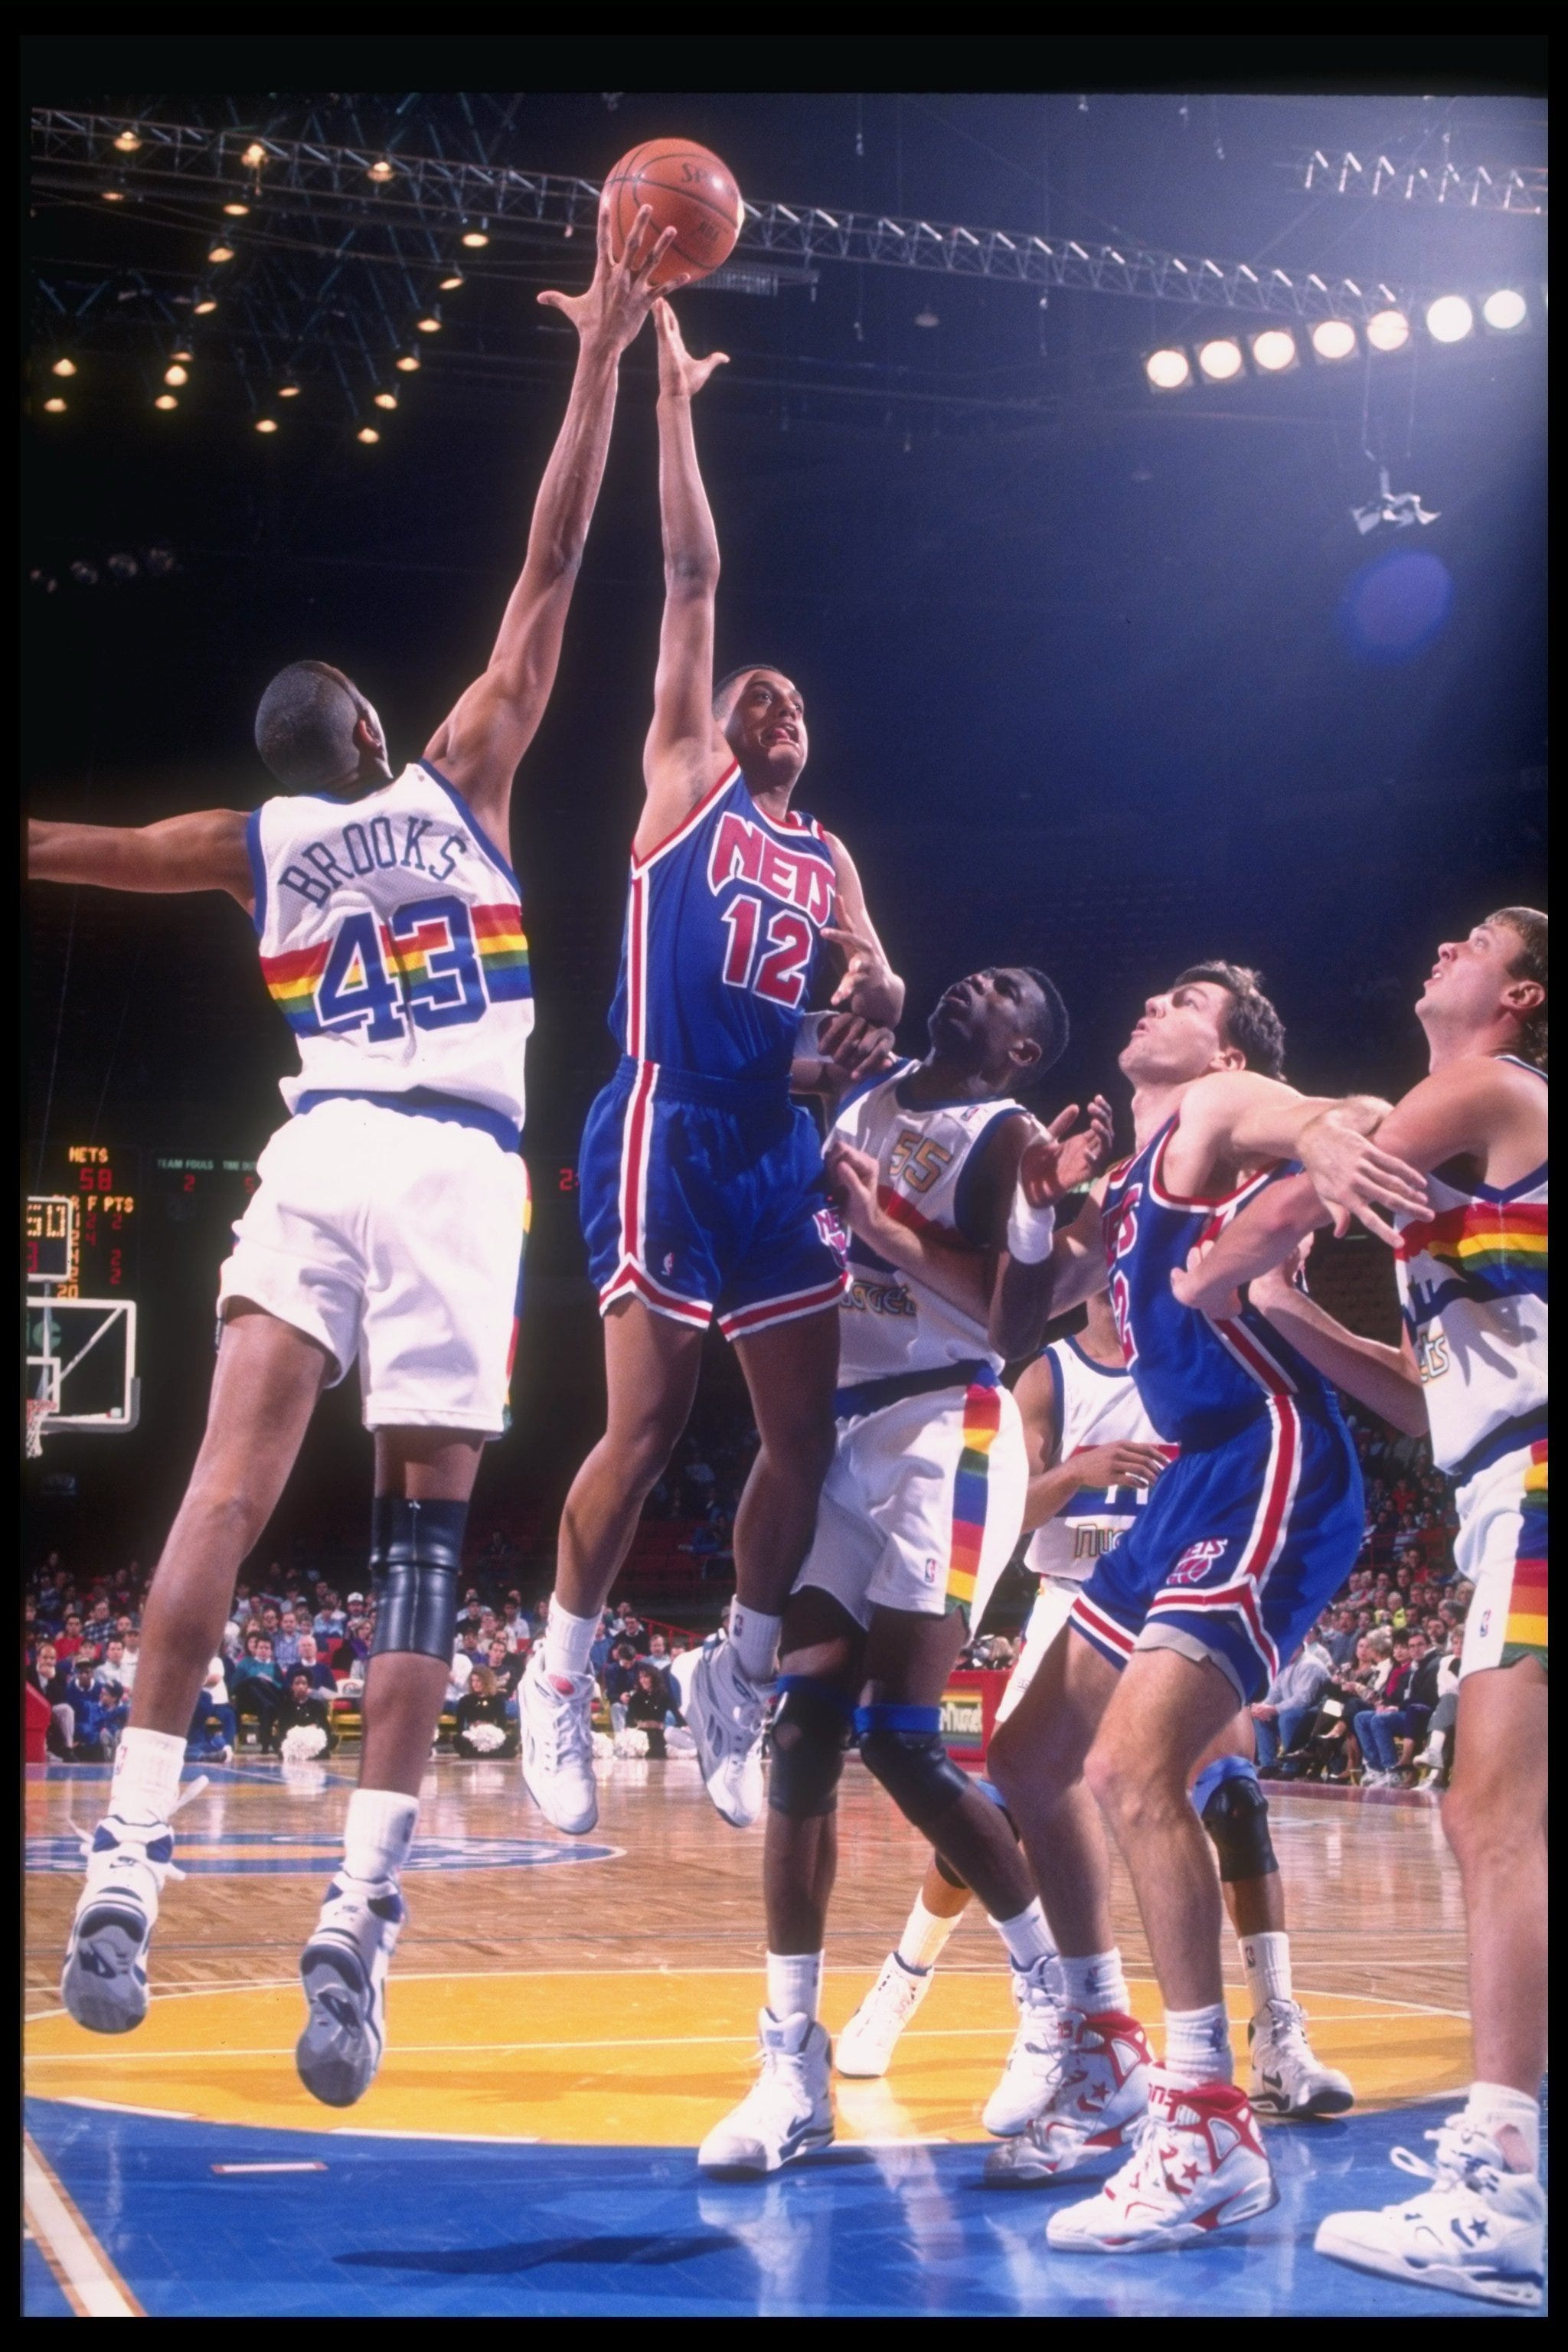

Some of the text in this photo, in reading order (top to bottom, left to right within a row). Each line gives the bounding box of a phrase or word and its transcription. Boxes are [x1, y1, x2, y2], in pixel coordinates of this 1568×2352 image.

[278, 815, 467, 909] BROOKS
[707, 811, 836, 929] NETS
[313, 894, 491, 1044] 43
[720, 893, 813, 1010] 12
[68, 1146, 109, 1164] NETS
[157, 1158, 214, 1170] TEAM FOULS
[889, 1129, 953, 1193] 55
[80, 1167, 113, 1191] 58
[183, 1174, 196, 1192] 2
[103, 1195, 134, 1213] PTS
